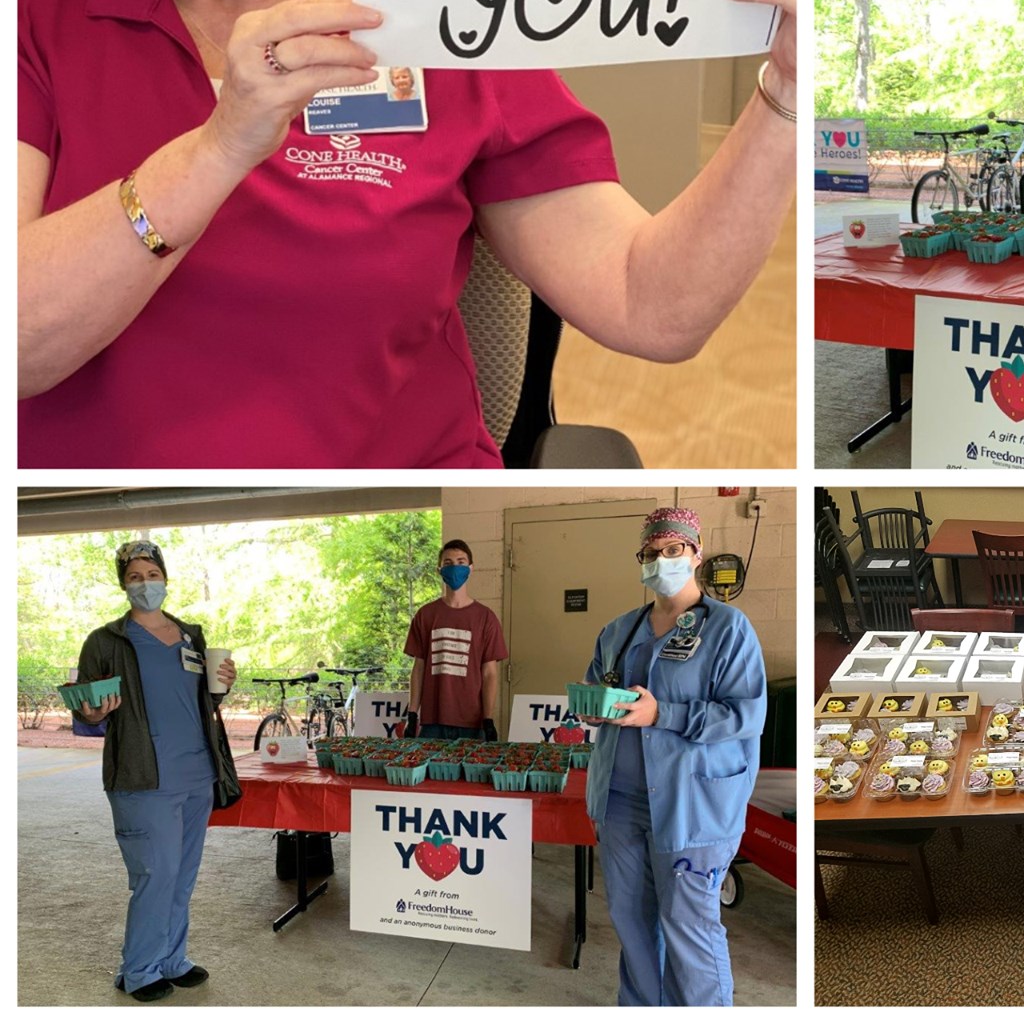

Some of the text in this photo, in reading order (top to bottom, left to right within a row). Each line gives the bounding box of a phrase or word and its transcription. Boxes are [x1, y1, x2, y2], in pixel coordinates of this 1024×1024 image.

[286, 147, 403, 170] CONE HEALTH
[821, 148, 862, 159] Heroes!
[304, 163, 383, 177] Cancer Center
[308, 172, 353, 181] ALAMANCE
[354, 174, 393, 189] REGIONAL
[988, 430, 997, 439] A
[998, 433, 1018, 443] gift
[375, 804, 508, 841] THANK
[414, 888, 460, 900] A gift from
[408, 901, 474, 916] FreedomHouse
[380, 917, 393, 925] and
[404, 919, 442, 930] anonymous
[443, 923, 473, 933] business
[474, 926, 497, 936] donor
